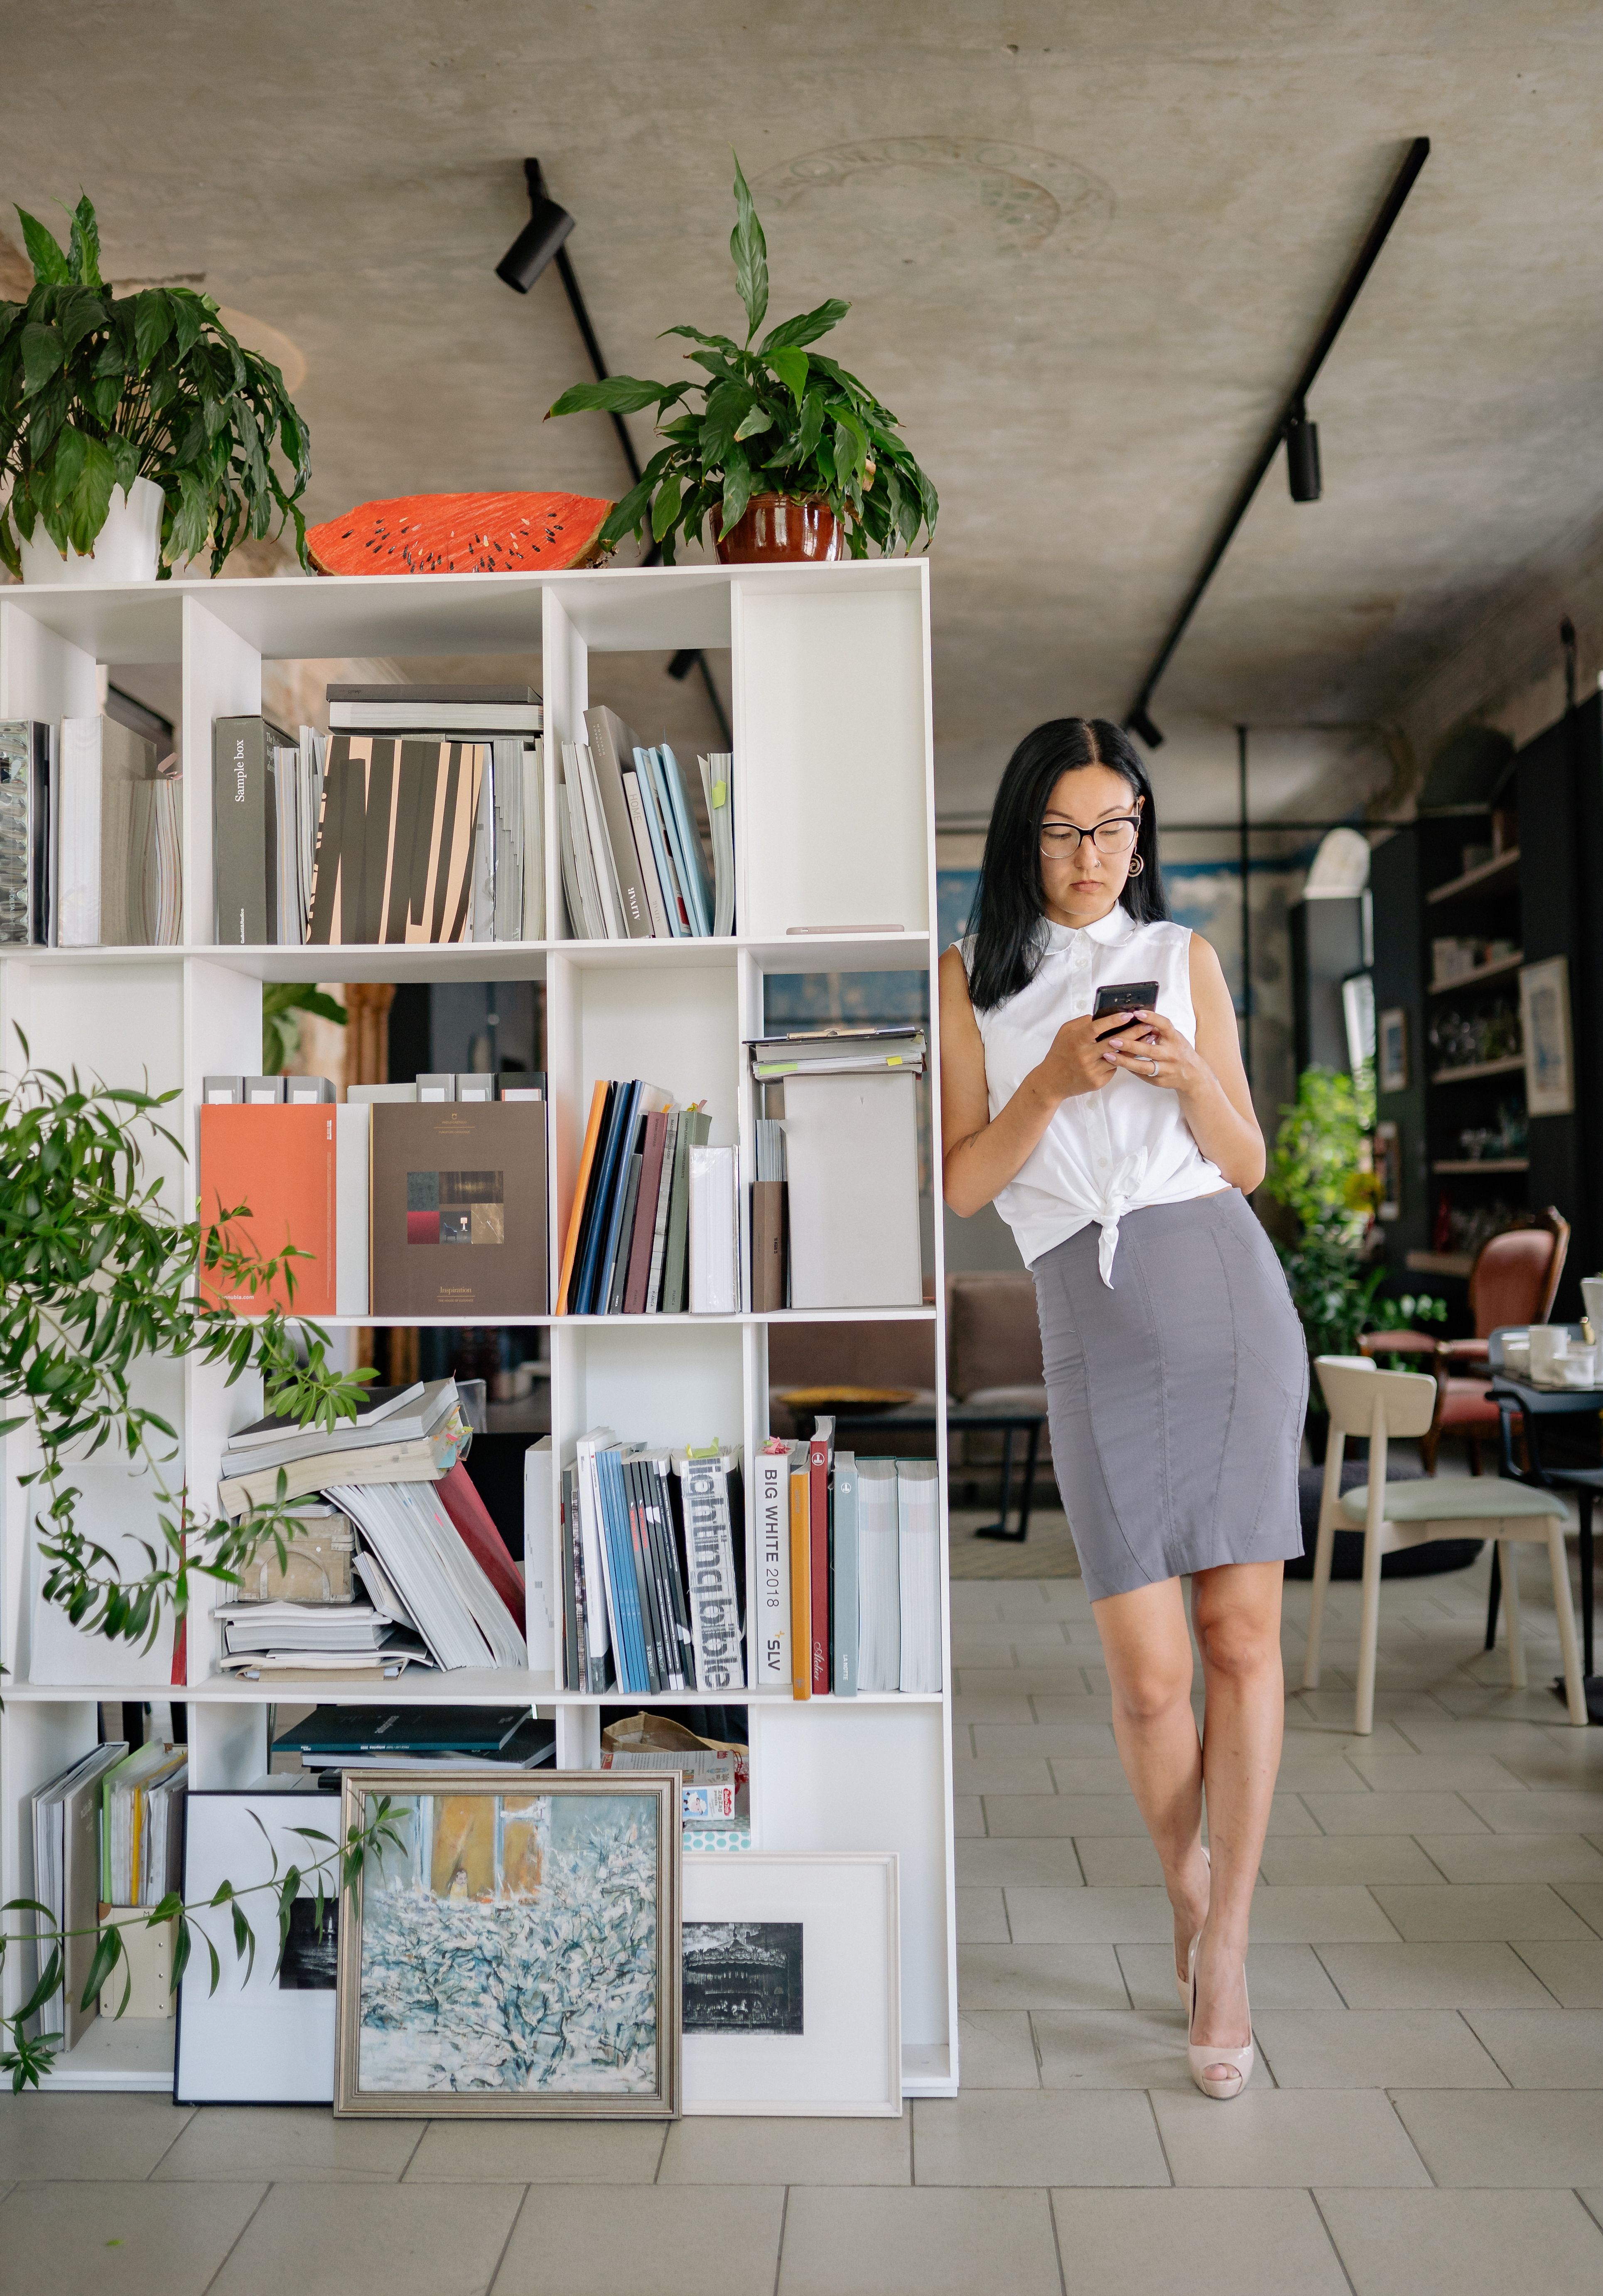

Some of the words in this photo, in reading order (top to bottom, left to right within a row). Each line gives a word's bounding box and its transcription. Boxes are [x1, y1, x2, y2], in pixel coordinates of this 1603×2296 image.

[234, 739, 244, 760] box
[593, 725, 601, 756] CONTRACT
[597, 724, 606, 755] DIVISION
[234, 761, 247, 802] Sample
[629, 794, 642, 822] HOME
[628, 887, 641, 920] ALIVAR
[653, 901, 661, 922] ALIVAR
[440, 1286, 471, 1295] Inspiration
[765, 1469, 778, 1499] BIG
[688, 1458, 727, 1593] lighting
[766, 1506, 779, 1562] WHITE
[766, 1569, 780, 1607] 2018
[699, 1598, 738, 1689] bible
[767, 1640, 781, 1671] SLV
[813, 1641, 825, 1681] Atelier
